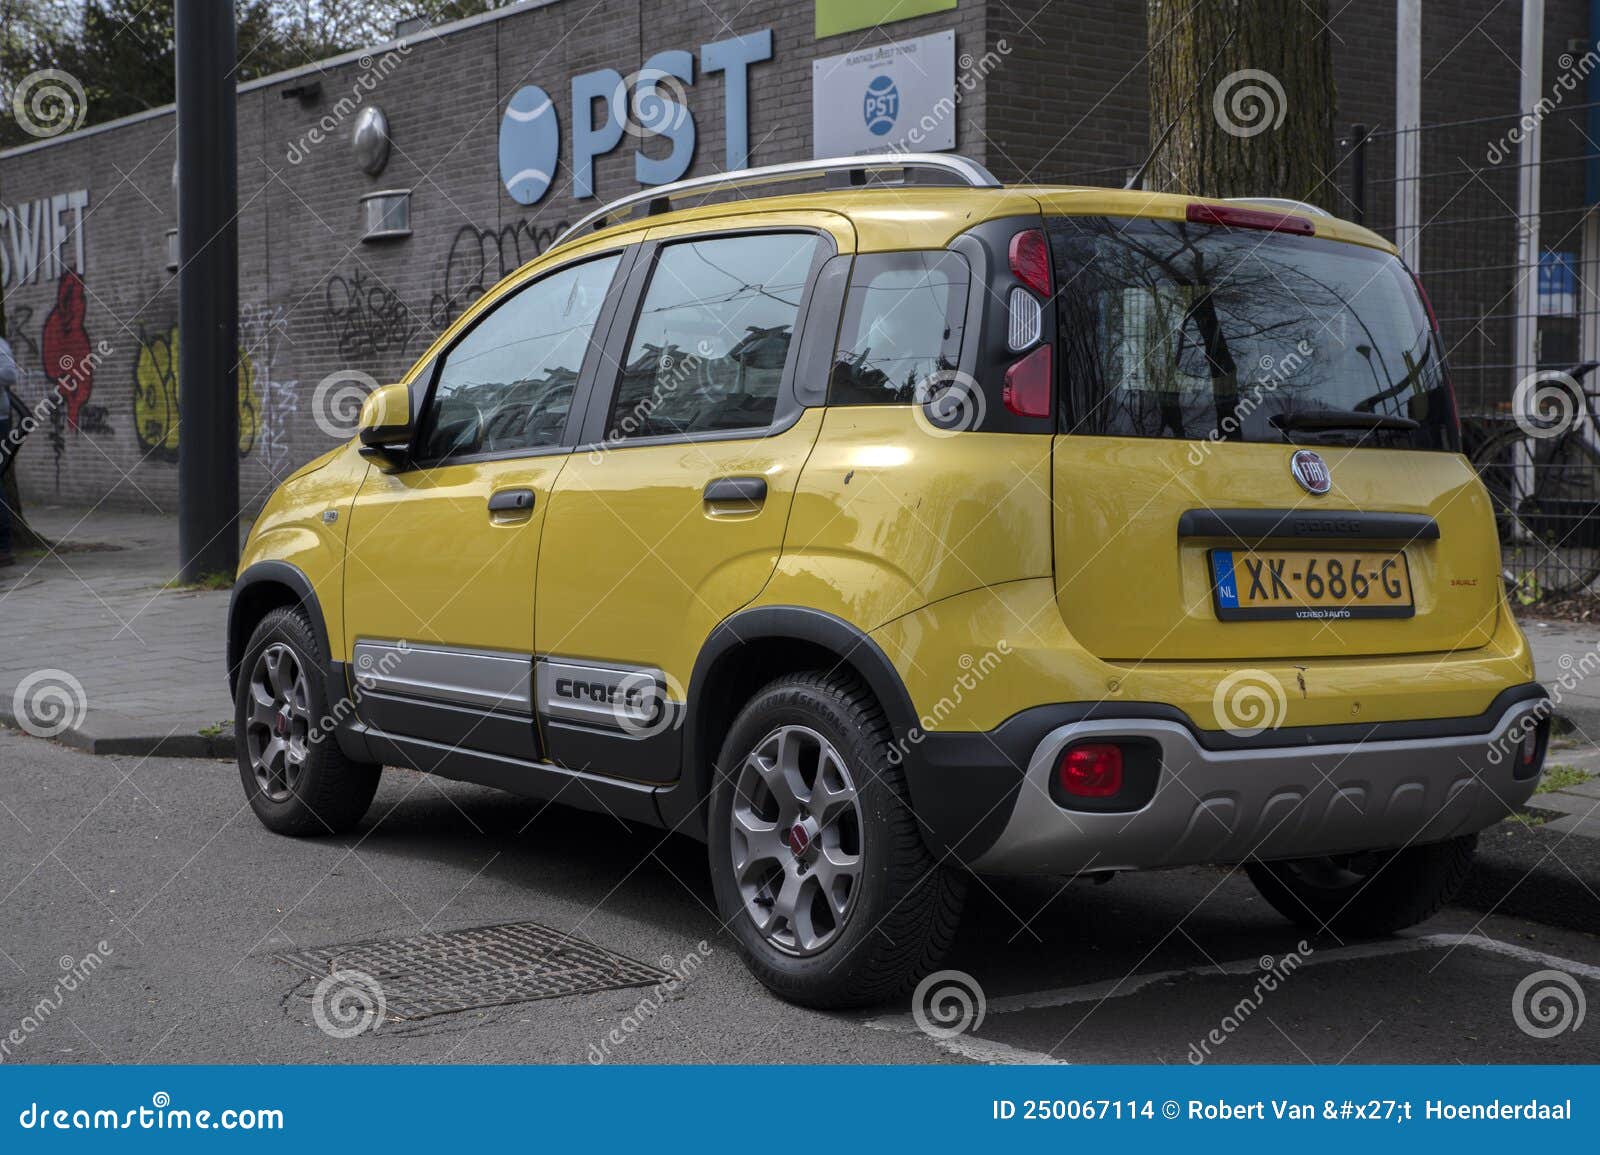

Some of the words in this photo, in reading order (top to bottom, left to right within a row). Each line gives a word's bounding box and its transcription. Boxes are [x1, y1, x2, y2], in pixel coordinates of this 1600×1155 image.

[572, 28, 772, 199] PST
[866, 93, 897, 118] PST
[1299, 461, 1326, 482] FIAT
[1245, 558, 1402, 600] XK-686-G
[1220, 586, 1235, 599] NL
